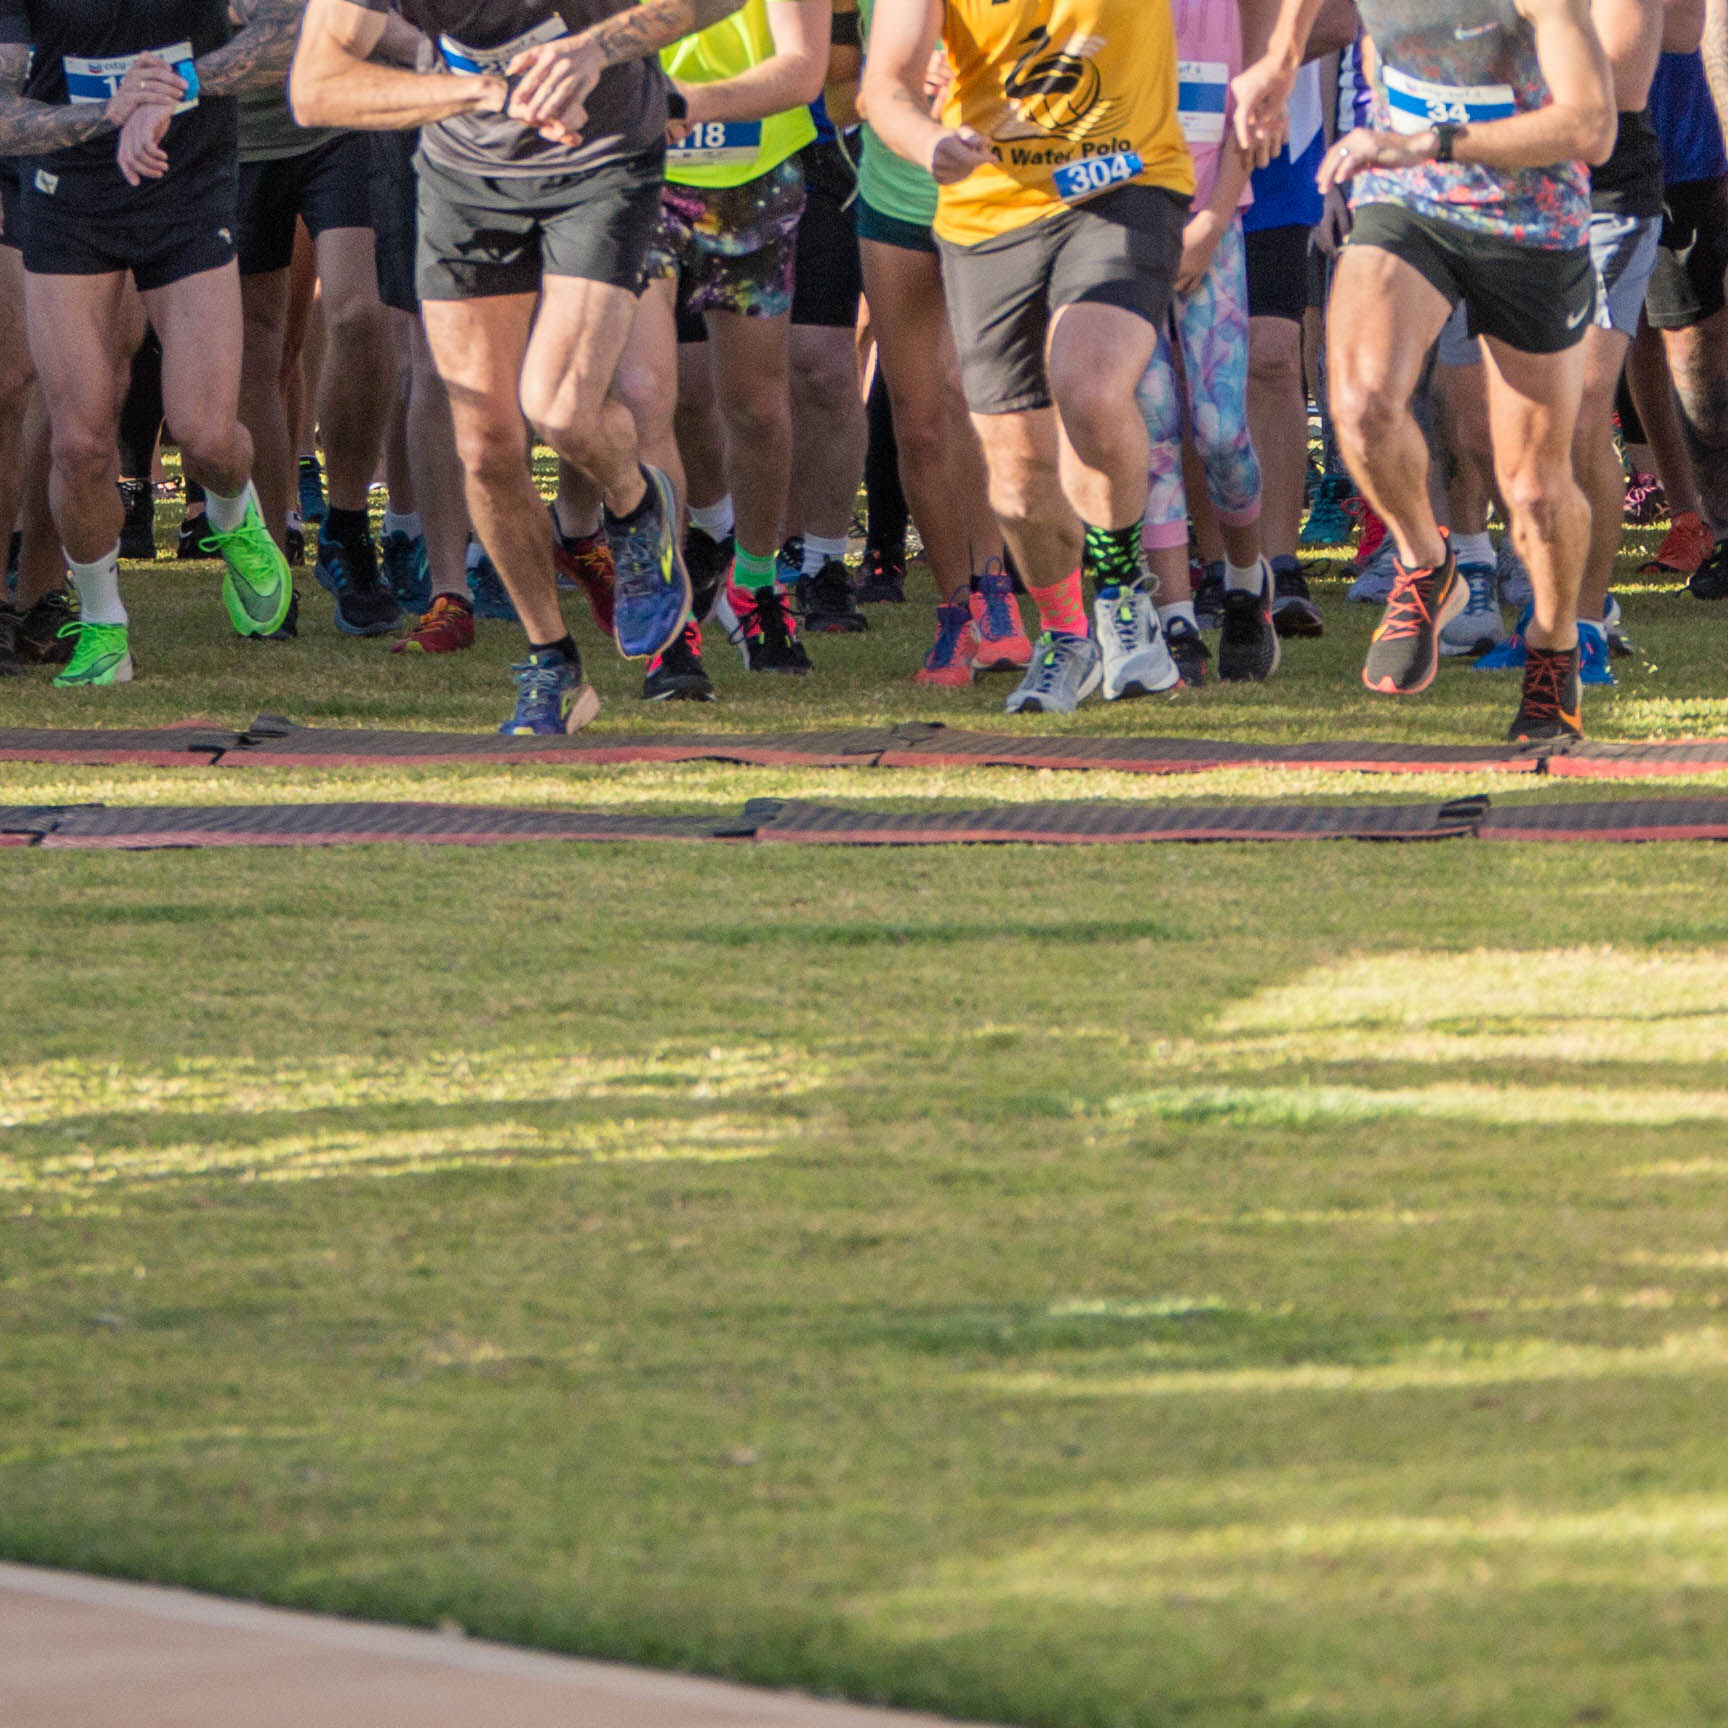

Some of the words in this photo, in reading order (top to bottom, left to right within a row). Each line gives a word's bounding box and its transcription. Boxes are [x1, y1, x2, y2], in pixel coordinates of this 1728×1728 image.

[1426, 98, 1471, 124] 34
[1011, 146, 1071, 167] Water
[1081, 136, 1132, 159] Polo
[1067, 154, 1133, 194] 304
